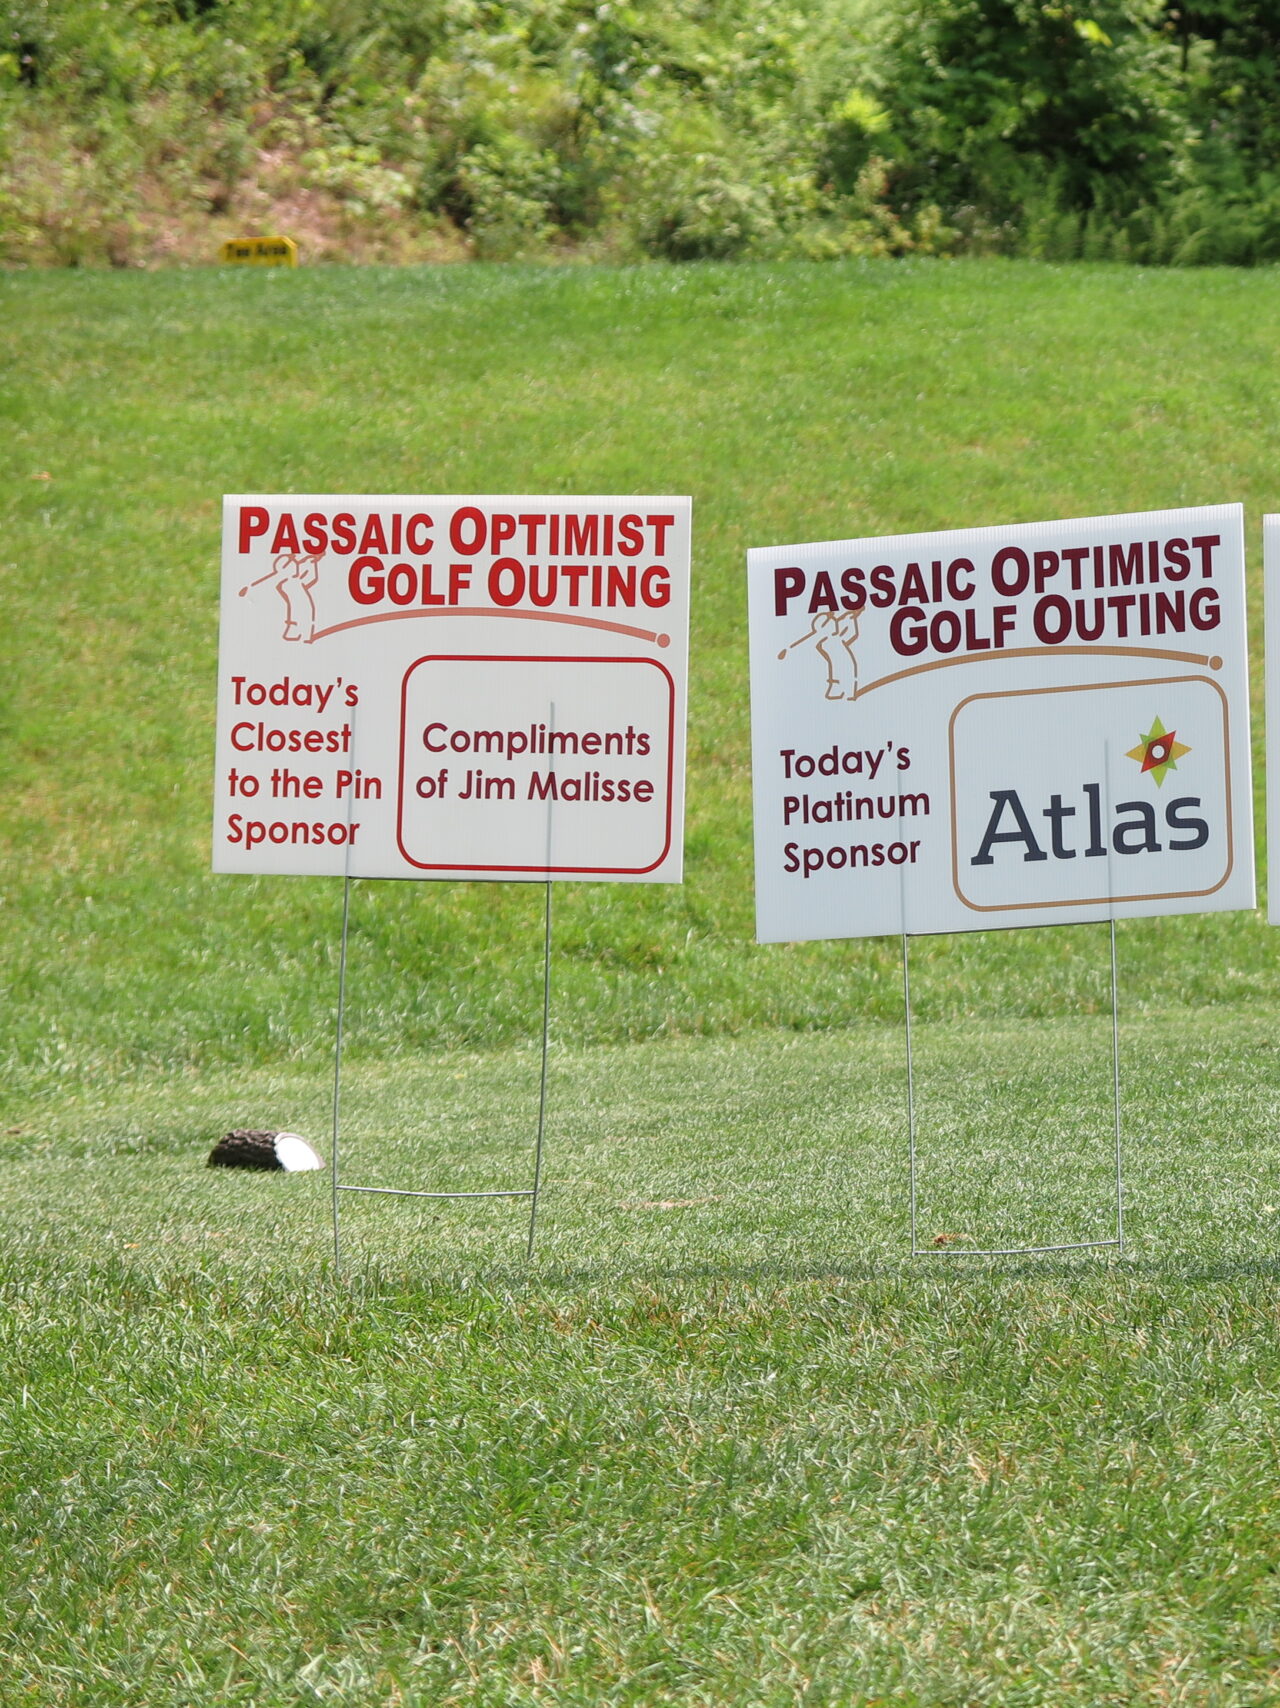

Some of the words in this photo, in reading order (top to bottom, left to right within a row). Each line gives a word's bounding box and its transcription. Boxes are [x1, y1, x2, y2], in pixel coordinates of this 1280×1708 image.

[238, 506, 434, 555] PASSAIC
[449, 507, 675, 556] OPTIMIST
[348, 556, 473, 605] GOLF
[488, 558, 671, 608] OUTING
[774, 558, 976, 616] PASSAIC
[991, 534, 1221, 596] OPTIMIST
[889, 605, 1017, 656] GOLF
[1033, 587, 1221, 645] OUTING
[230, 722, 351, 753] Closest
[422, 723, 651, 760] Compliments
[228, 768, 259, 798] to
[271, 768, 323, 799] the
[336, 770, 382, 800] Pin
[416, 769, 448, 800] of
[458, 771, 515, 800] Jim
[527, 771, 654, 802] Malisse
[783, 791, 930, 825] Platinum
[970, 783, 1210, 866] Atlas
[226, 815, 360, 850] Sponsor
[783, 837, 921, 878] Sponsor
